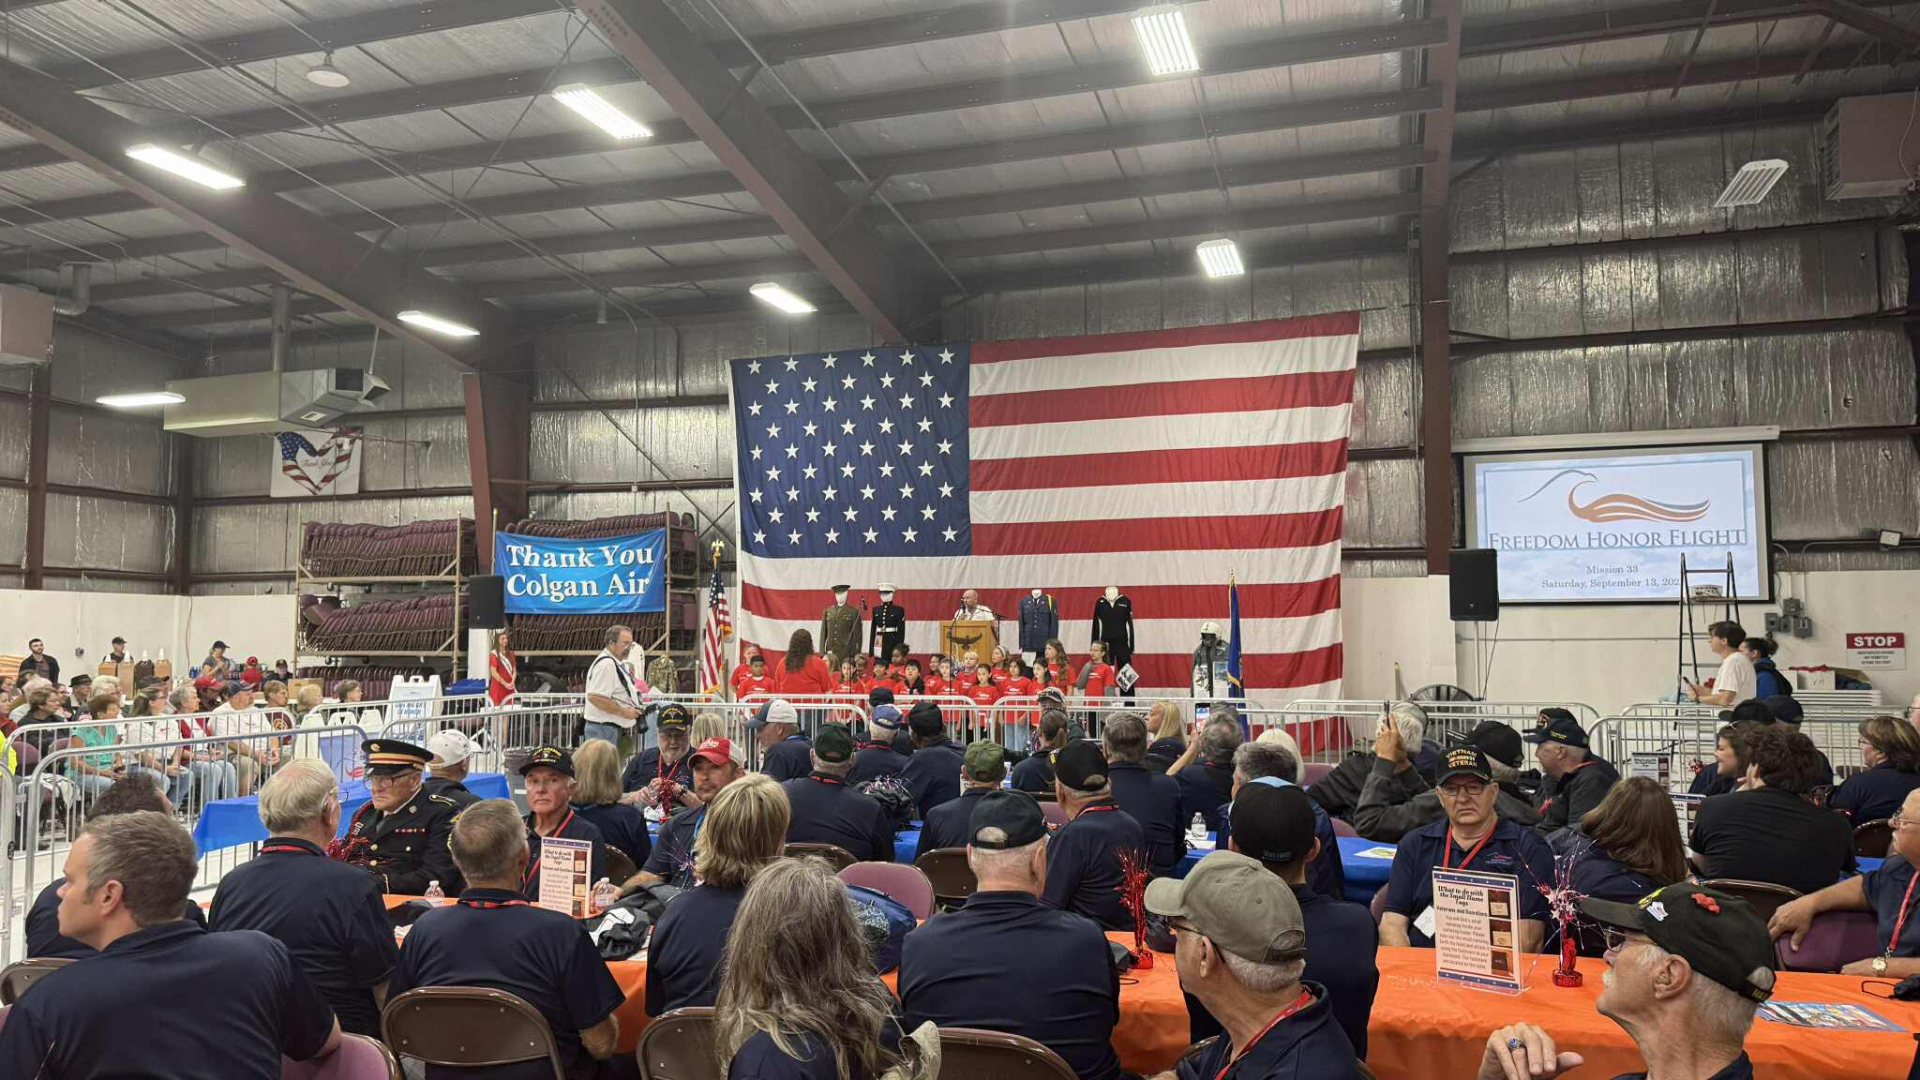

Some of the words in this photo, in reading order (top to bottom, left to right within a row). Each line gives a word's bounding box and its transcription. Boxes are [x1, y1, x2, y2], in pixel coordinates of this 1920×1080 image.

[1490, 533, 1580, 550] FREEDOM
[1587, 531, 1664, 547] HONOR
[1670, 528, 1745, 545] FLIGHT
[506, 545, 596, 568] Thank
[600, 545, 654, 567] You
[1586, 565, 1624, 575] Mission
[1626, 564, 1639, 574] 33
[506, 573, 599, 602] Colgan
[605, 571, 650, 596] Air
[1541, 579, 1588, 589] Saturday,
[1590, 578, 1641, 588] September
[1645, 578, 1660, 587] 13,
[1662, 577, 1682, 586] 202
[1854, 636, 1897, 647] STOP
[1445, 749, 1477, 759] VIETNAM
